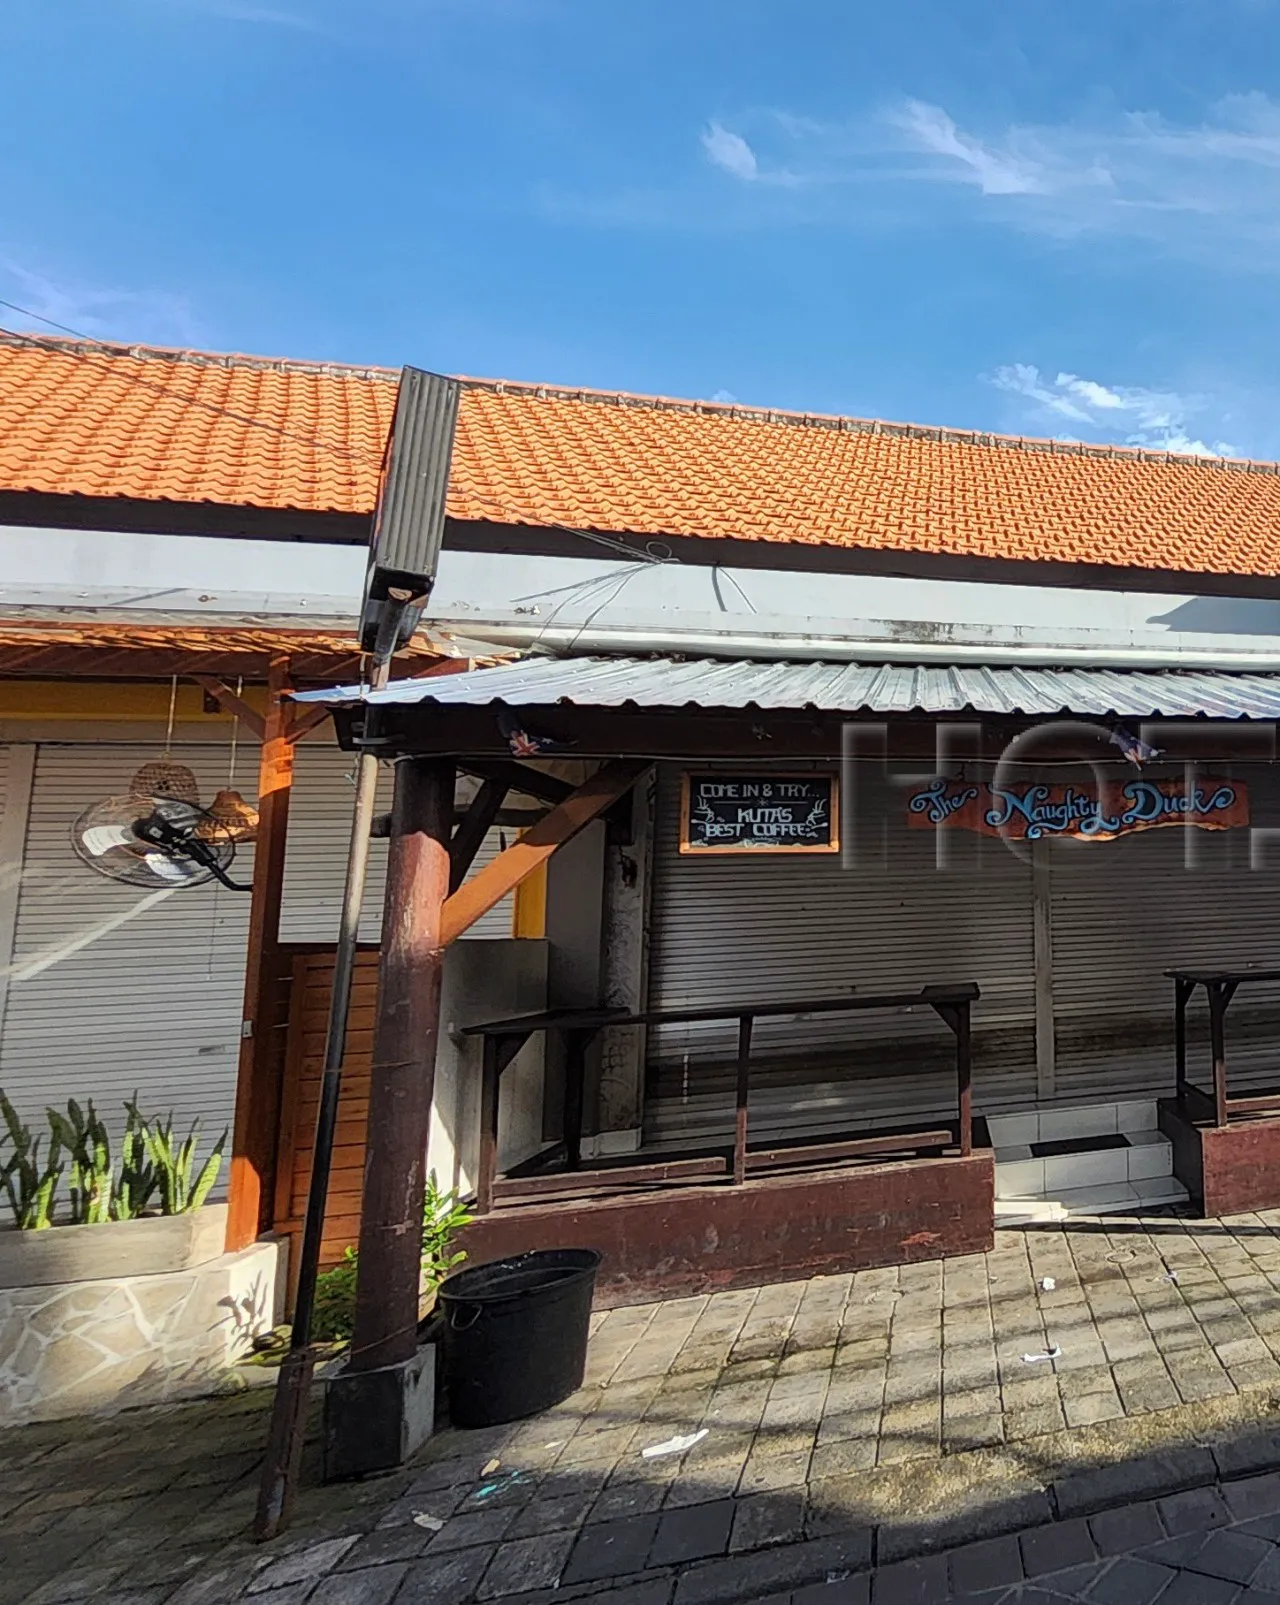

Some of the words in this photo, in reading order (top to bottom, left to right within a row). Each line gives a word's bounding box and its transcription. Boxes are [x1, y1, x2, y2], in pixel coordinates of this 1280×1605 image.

[700, 784, 739, 798] COME
[742, 784, 760, 798] IN
[762, 783, 773, 798] &
[910, 781, 978, 823] The
[986, 783, 1120, 839] Naughty
[1121, 781, 1235, 824] Duck
[704, 823, 744, 837] BEST
[752, 823, 807, 837] COFFEE
